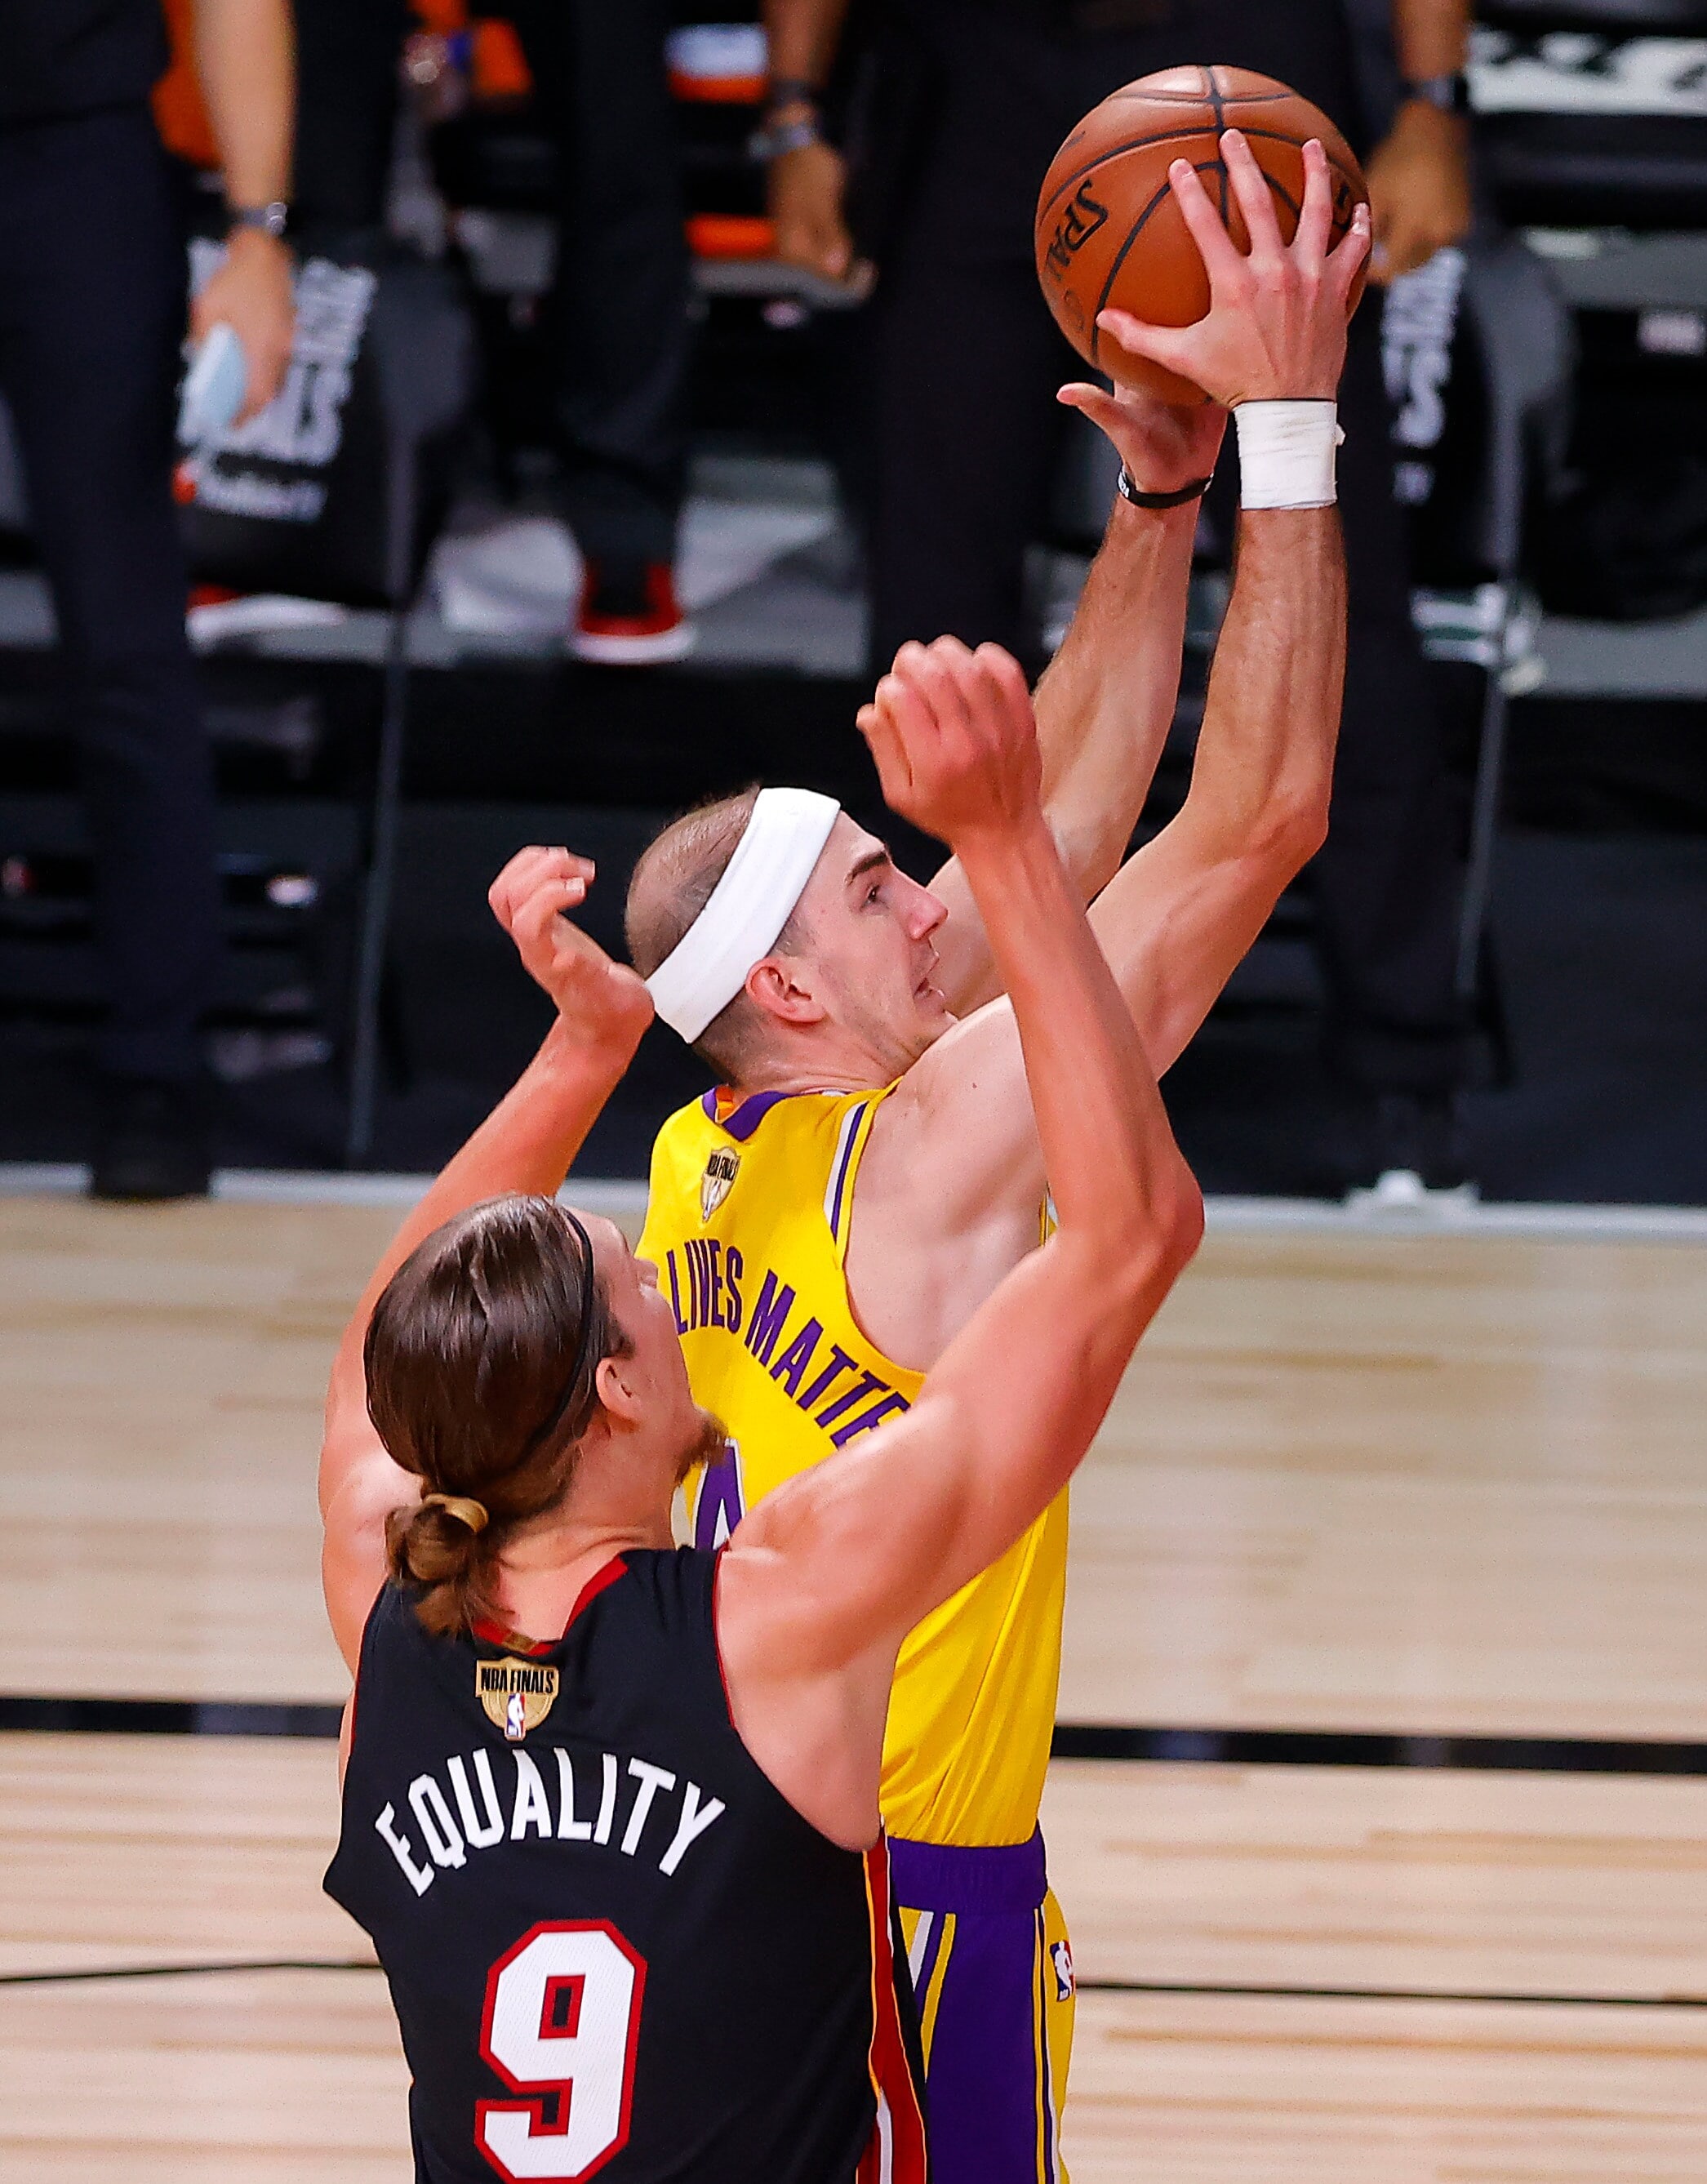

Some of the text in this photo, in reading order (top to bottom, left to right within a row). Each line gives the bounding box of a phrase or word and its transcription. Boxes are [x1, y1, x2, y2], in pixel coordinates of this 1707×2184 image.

[665, 1239, 744, 1334] LIVES
[480, 1667, 554, 1694] NBA FINALS
[375, 1746, 726, 1897] EQUALITY
[474, 1918, 648, 2184] 9
